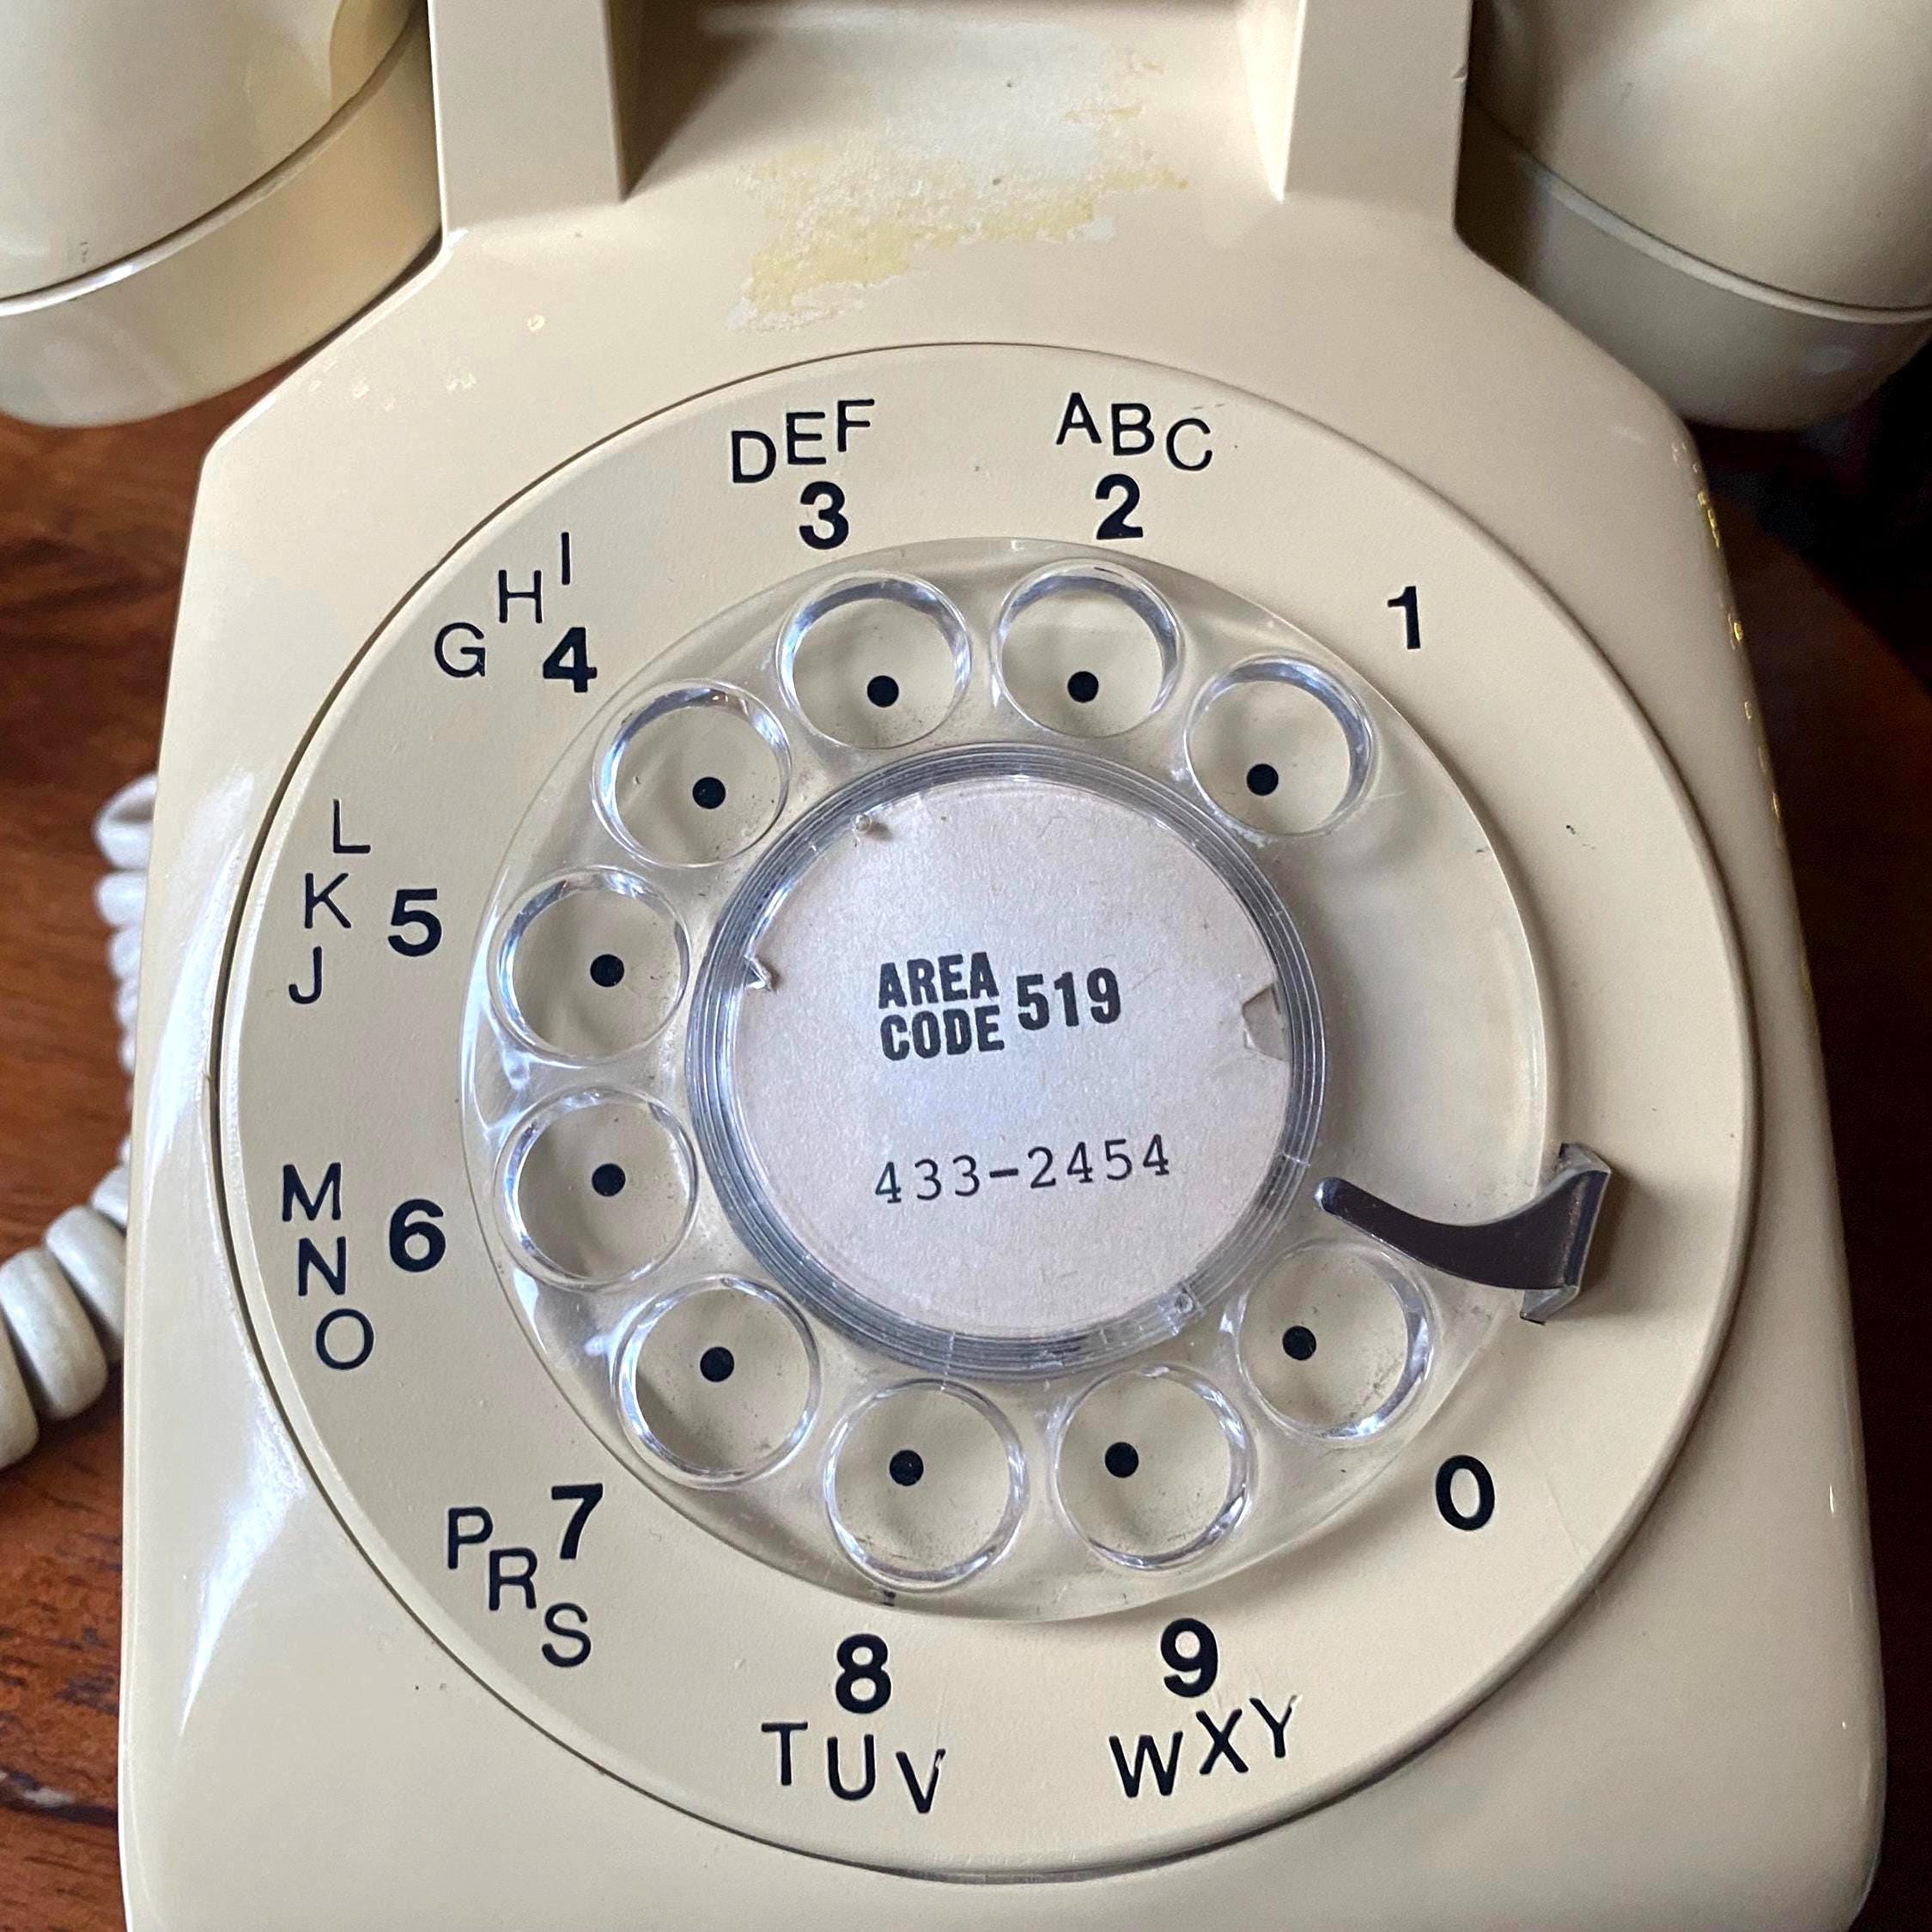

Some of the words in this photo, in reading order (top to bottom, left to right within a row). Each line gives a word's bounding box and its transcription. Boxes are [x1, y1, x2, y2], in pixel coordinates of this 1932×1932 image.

[799, 481, 848, 550] 3
[1096, 474, 1143, 539] 2
[1388, 586, 1420, 649] 1
[543, 627, 597, 693] 4
[388, 888, 441, 957] 5
[879, 952, 999, 1009] AREA
[1017, 968, 1121, 1031] 519
[881, 1005, 1005, 1061] CODE
[876, 1134, 1170, 1204] 433-2454
[389, 1199, 446, 1273] 6
[551, 1483, 604, 1559] 7
[1436, 1455, 1496, 1531] 0
[835, 1634, 891, 1714] 8
[1161, 1618, 1218, 1698] 9
